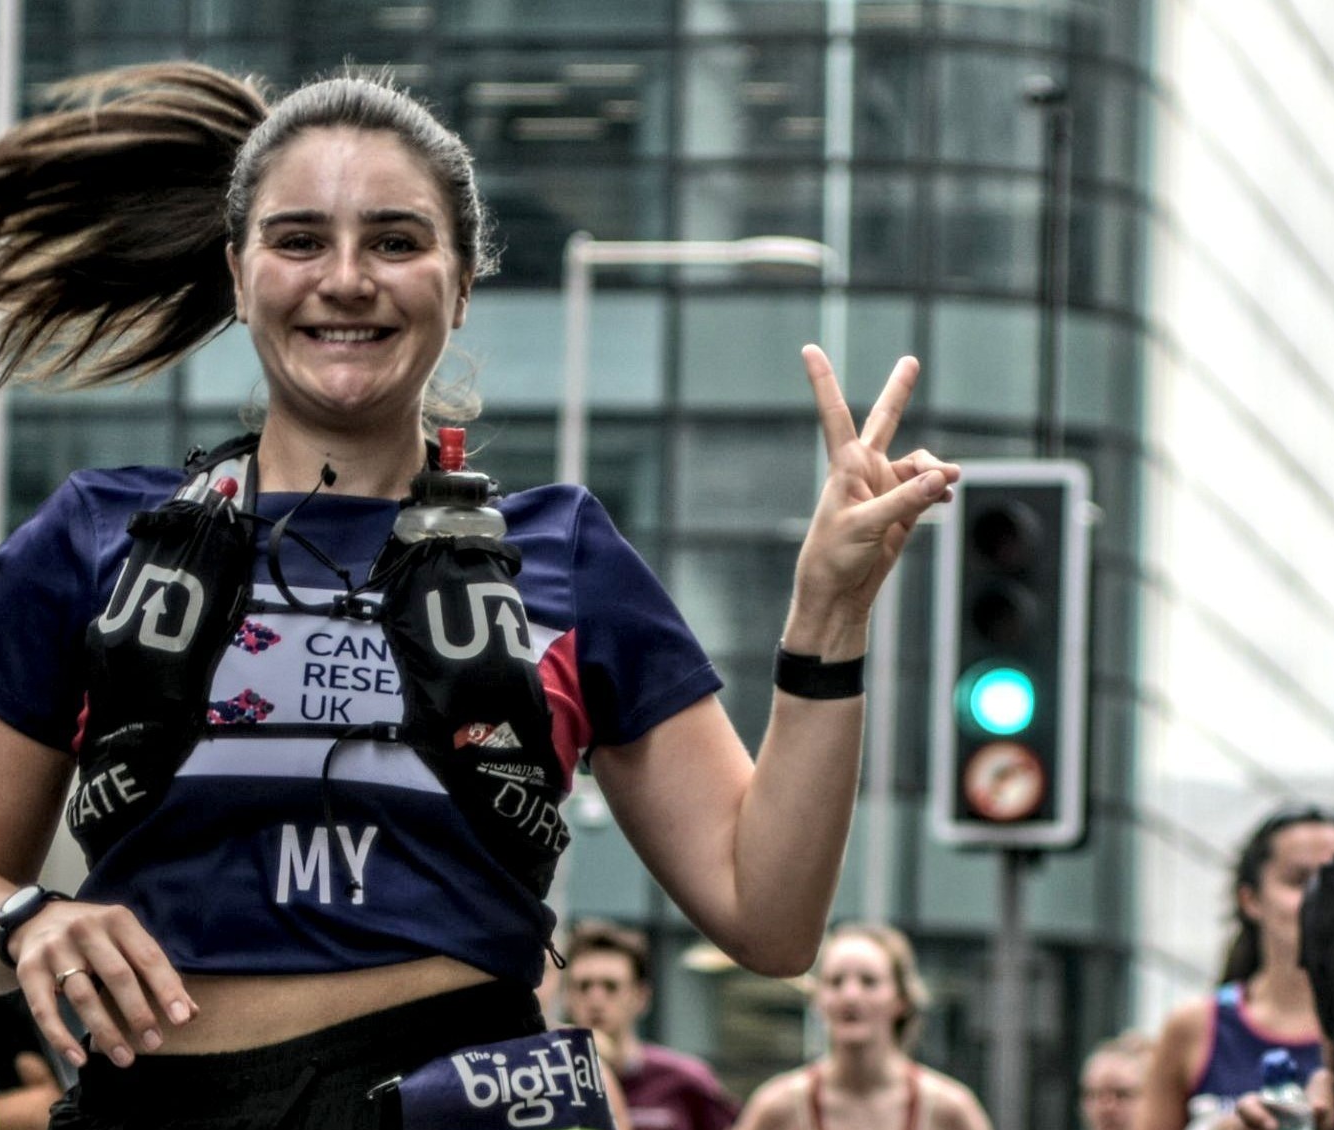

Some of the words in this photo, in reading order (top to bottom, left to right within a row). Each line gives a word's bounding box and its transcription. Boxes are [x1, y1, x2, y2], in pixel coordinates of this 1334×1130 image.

[306, 633, 387, 662] CAN
[303, 662, 404, 696] RESE
[300, 694, 353, 724] UK
[276, 824, 379, 905] MY
